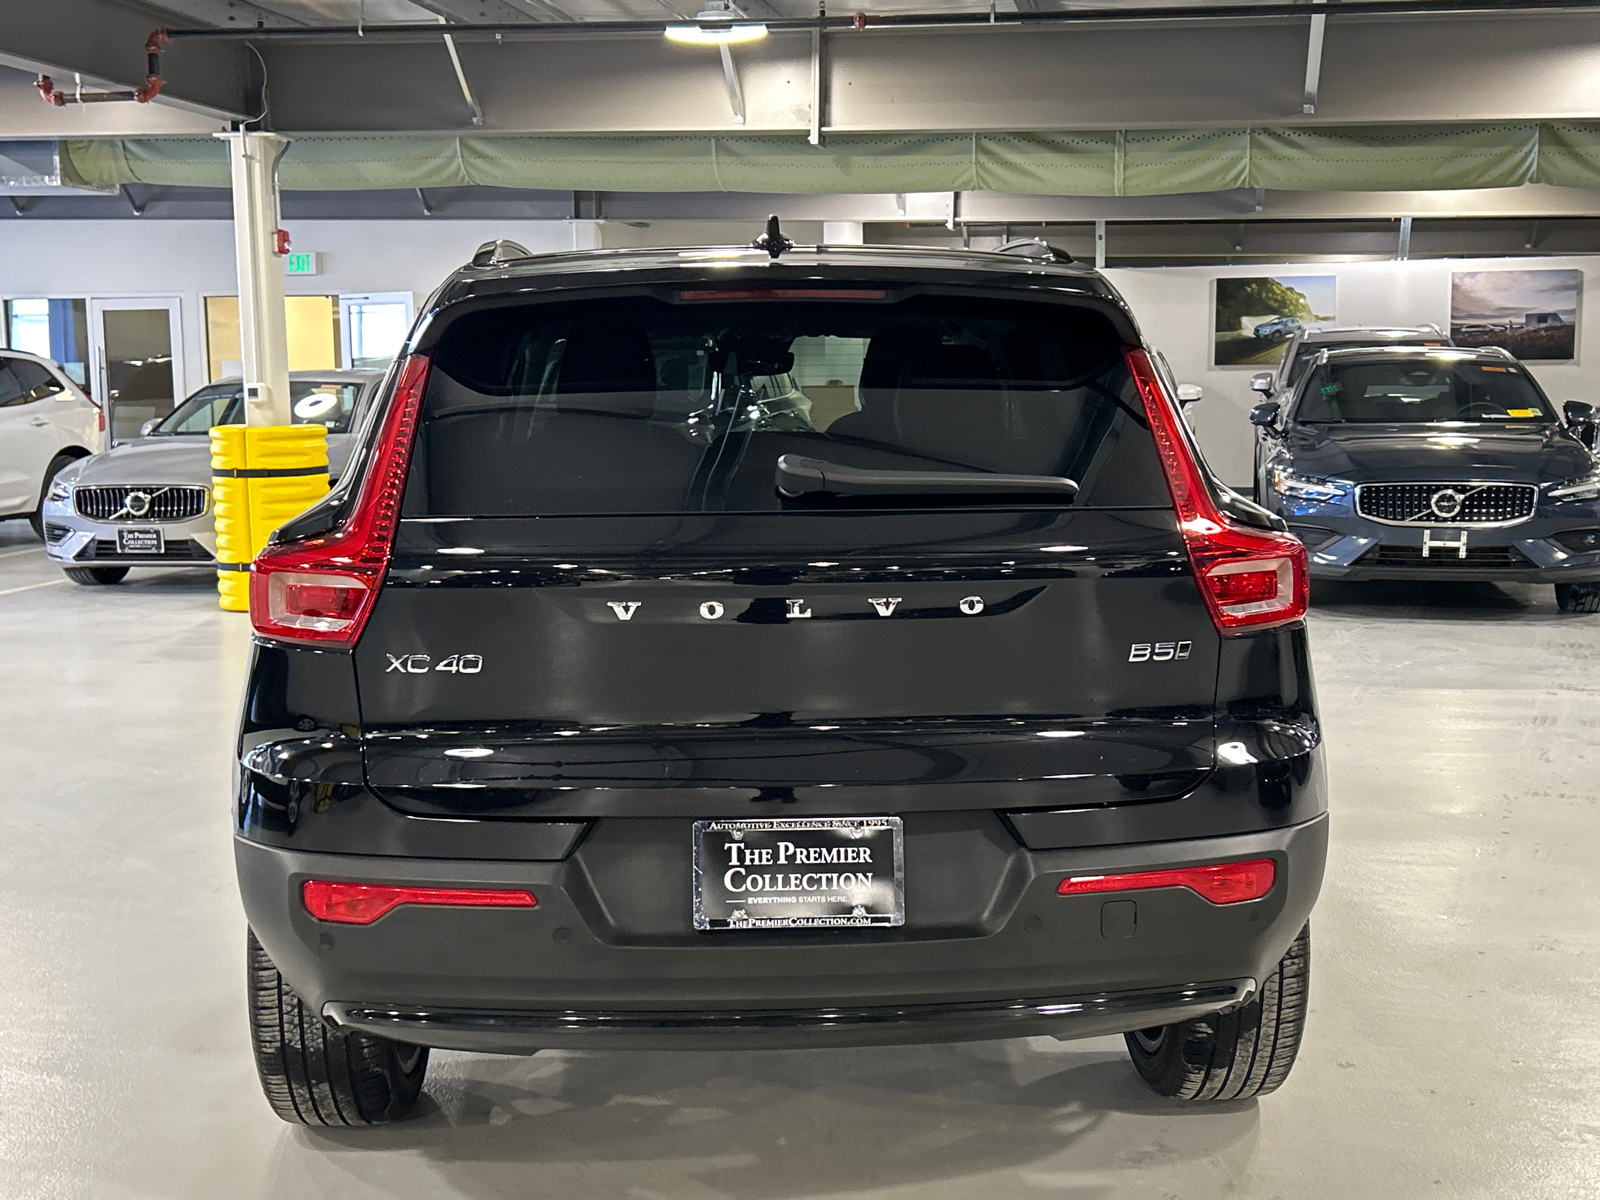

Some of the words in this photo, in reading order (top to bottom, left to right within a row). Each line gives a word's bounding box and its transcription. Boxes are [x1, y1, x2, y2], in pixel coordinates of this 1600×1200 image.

[289, 253, 310, 271] EXIT
[606, 596, 985, 621] VOLVO
[709, 821, 772, 830] AUTOMOTIVE
[863, 819, 888, 827] 1995
[724, 842, 773, 866] THE
[777, 841, 873, 864] PREMIER
[723, 867, 873, 892] COLLECTION
[747, 896, 797, 904] EVERYTHING
